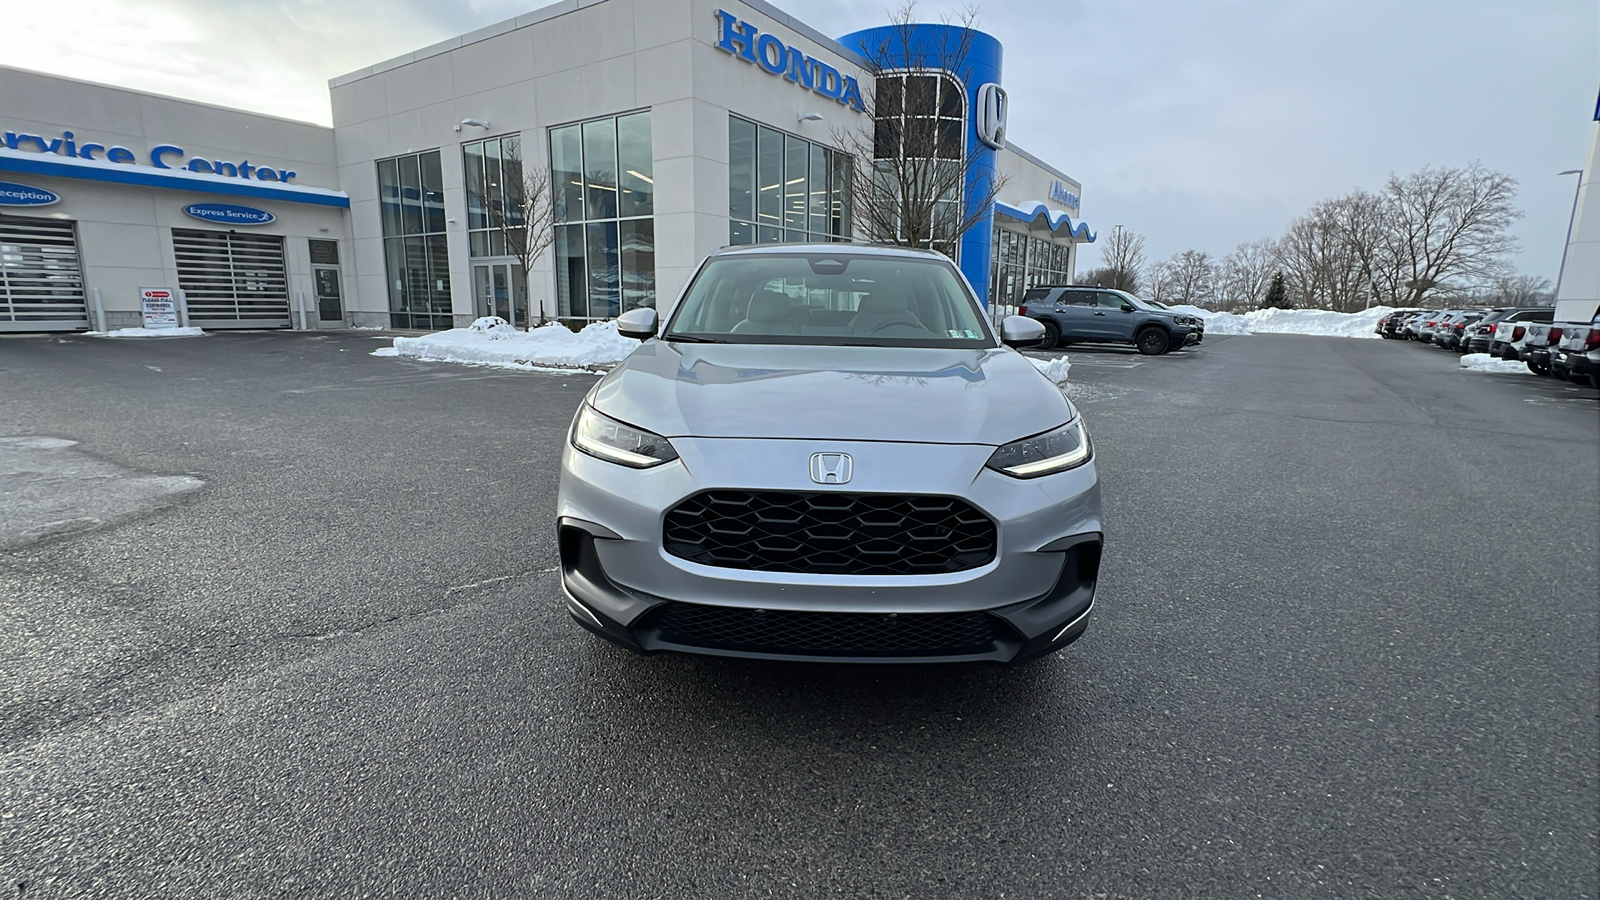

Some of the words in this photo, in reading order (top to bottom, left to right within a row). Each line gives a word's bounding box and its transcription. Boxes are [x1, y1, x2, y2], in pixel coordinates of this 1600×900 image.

[714, 9, 865, 113] HONDA
[0, 131, 136, 165] rvice
[150, 144, 296, 183] Center
[190, 206, 225, 217] Express
[226, 210, 259, 220] Service
